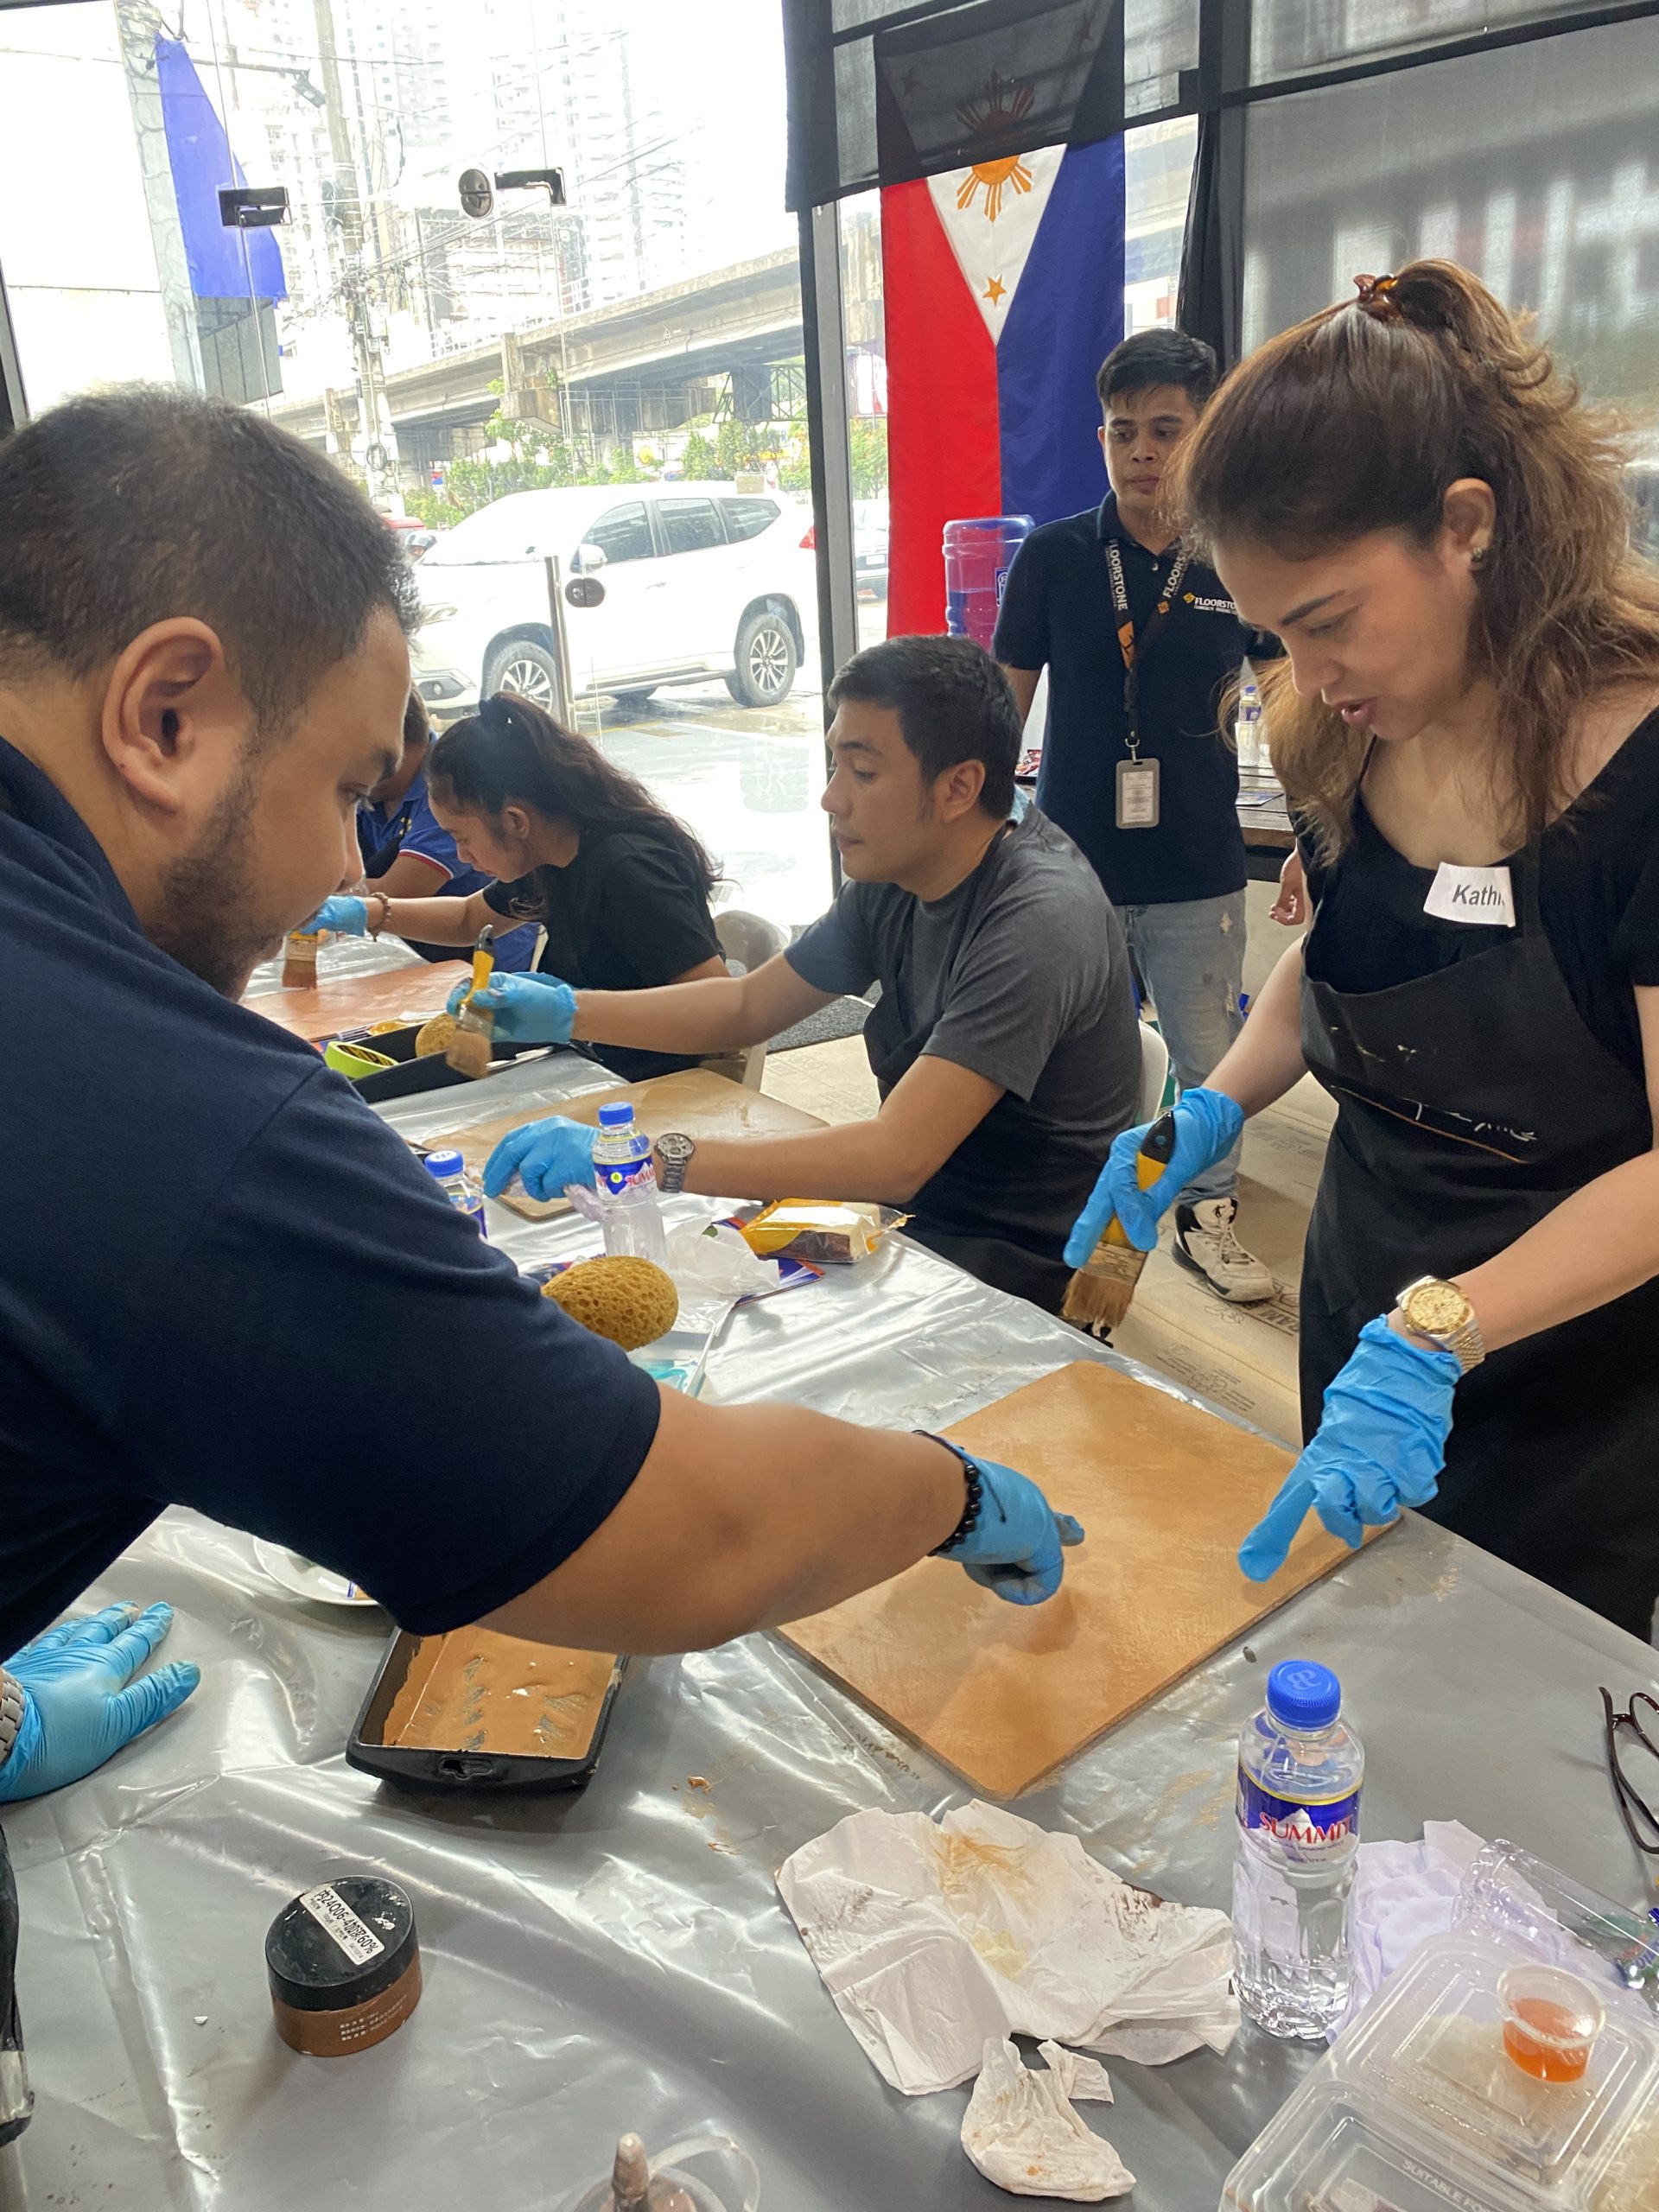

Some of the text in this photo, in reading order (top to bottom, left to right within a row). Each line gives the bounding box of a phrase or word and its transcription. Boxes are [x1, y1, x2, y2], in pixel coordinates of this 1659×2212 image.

[1162, 551, 1186, 598] FLOORS
[1194, 597, 1236, 610] FLOORSTO
[1259, 1812, 1353, 1844] SUMMIT
[1402, 2159, 1463, 2202] SUITABLE
